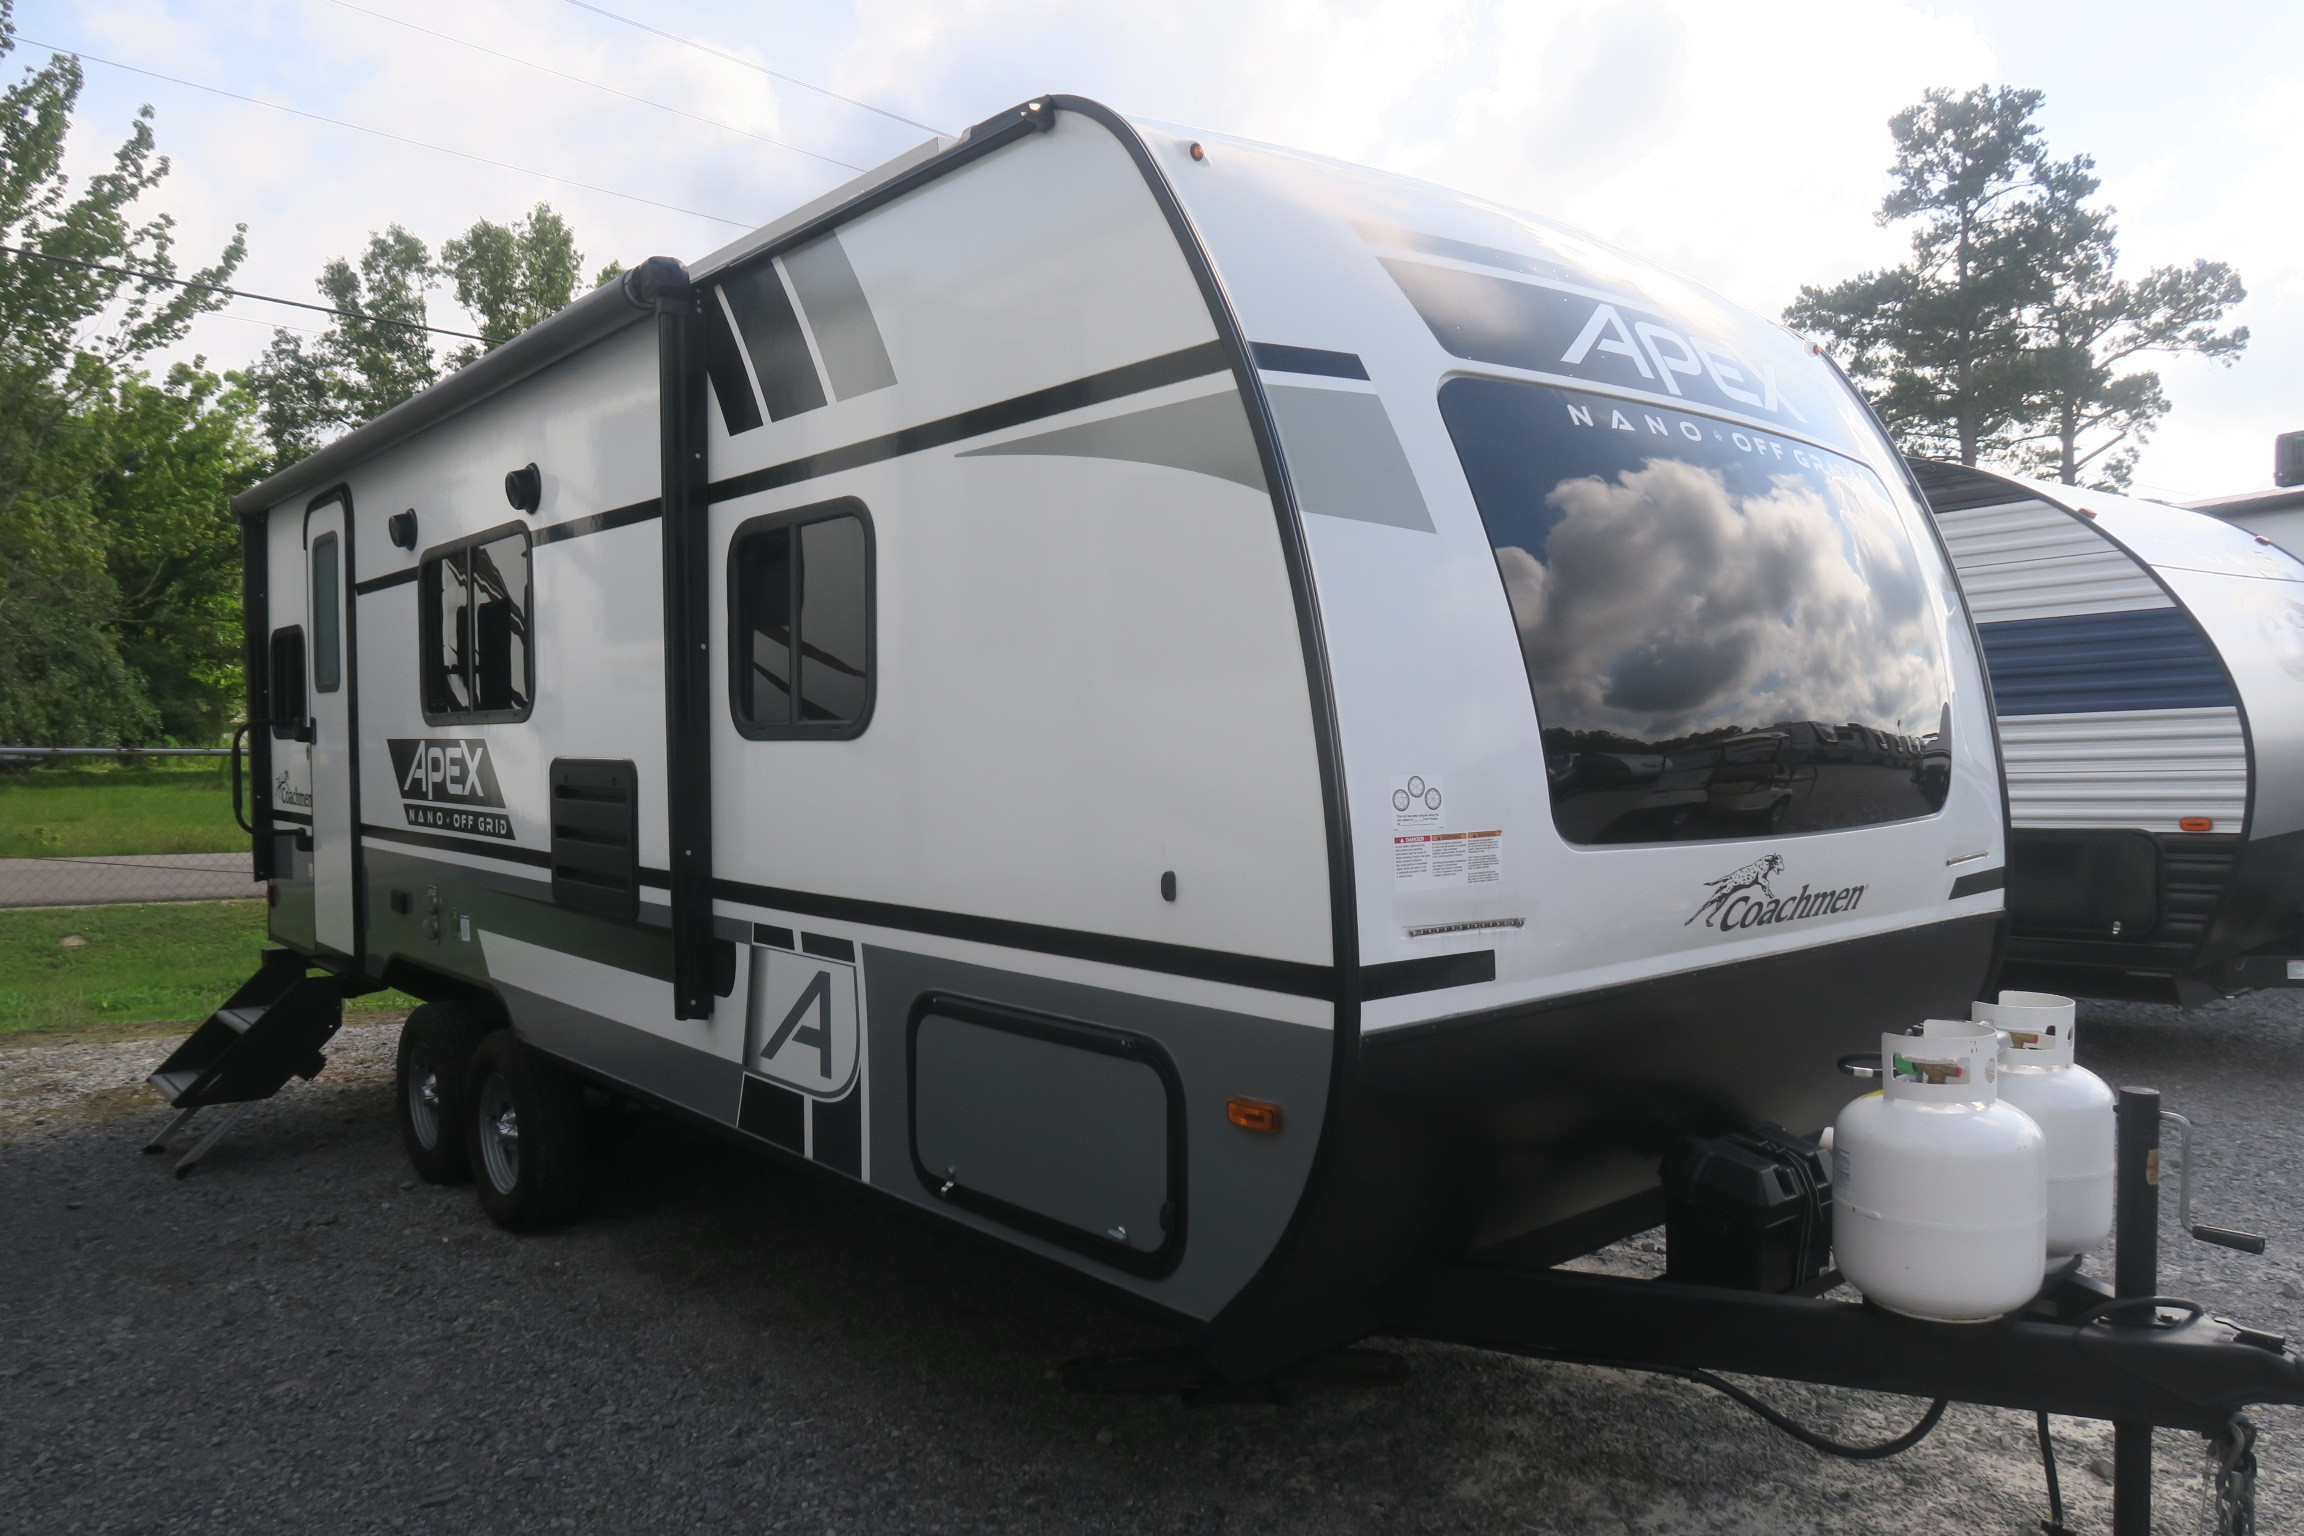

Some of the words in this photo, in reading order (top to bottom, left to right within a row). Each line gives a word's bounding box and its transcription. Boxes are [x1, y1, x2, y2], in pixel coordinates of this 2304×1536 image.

[1560, 303, 1807, 423] APEX
[1567, 404, 1702, 442] NANO
[1731, 432, 1784, 461] OFF
[403, 739, 485, 800] APEX
[408, 809, 443, 825] NANO
[453, 813, 474, 829] OFF
[478, 816, 507, 835] GRID
[1720, 883, 1866, 932] Coachmen
